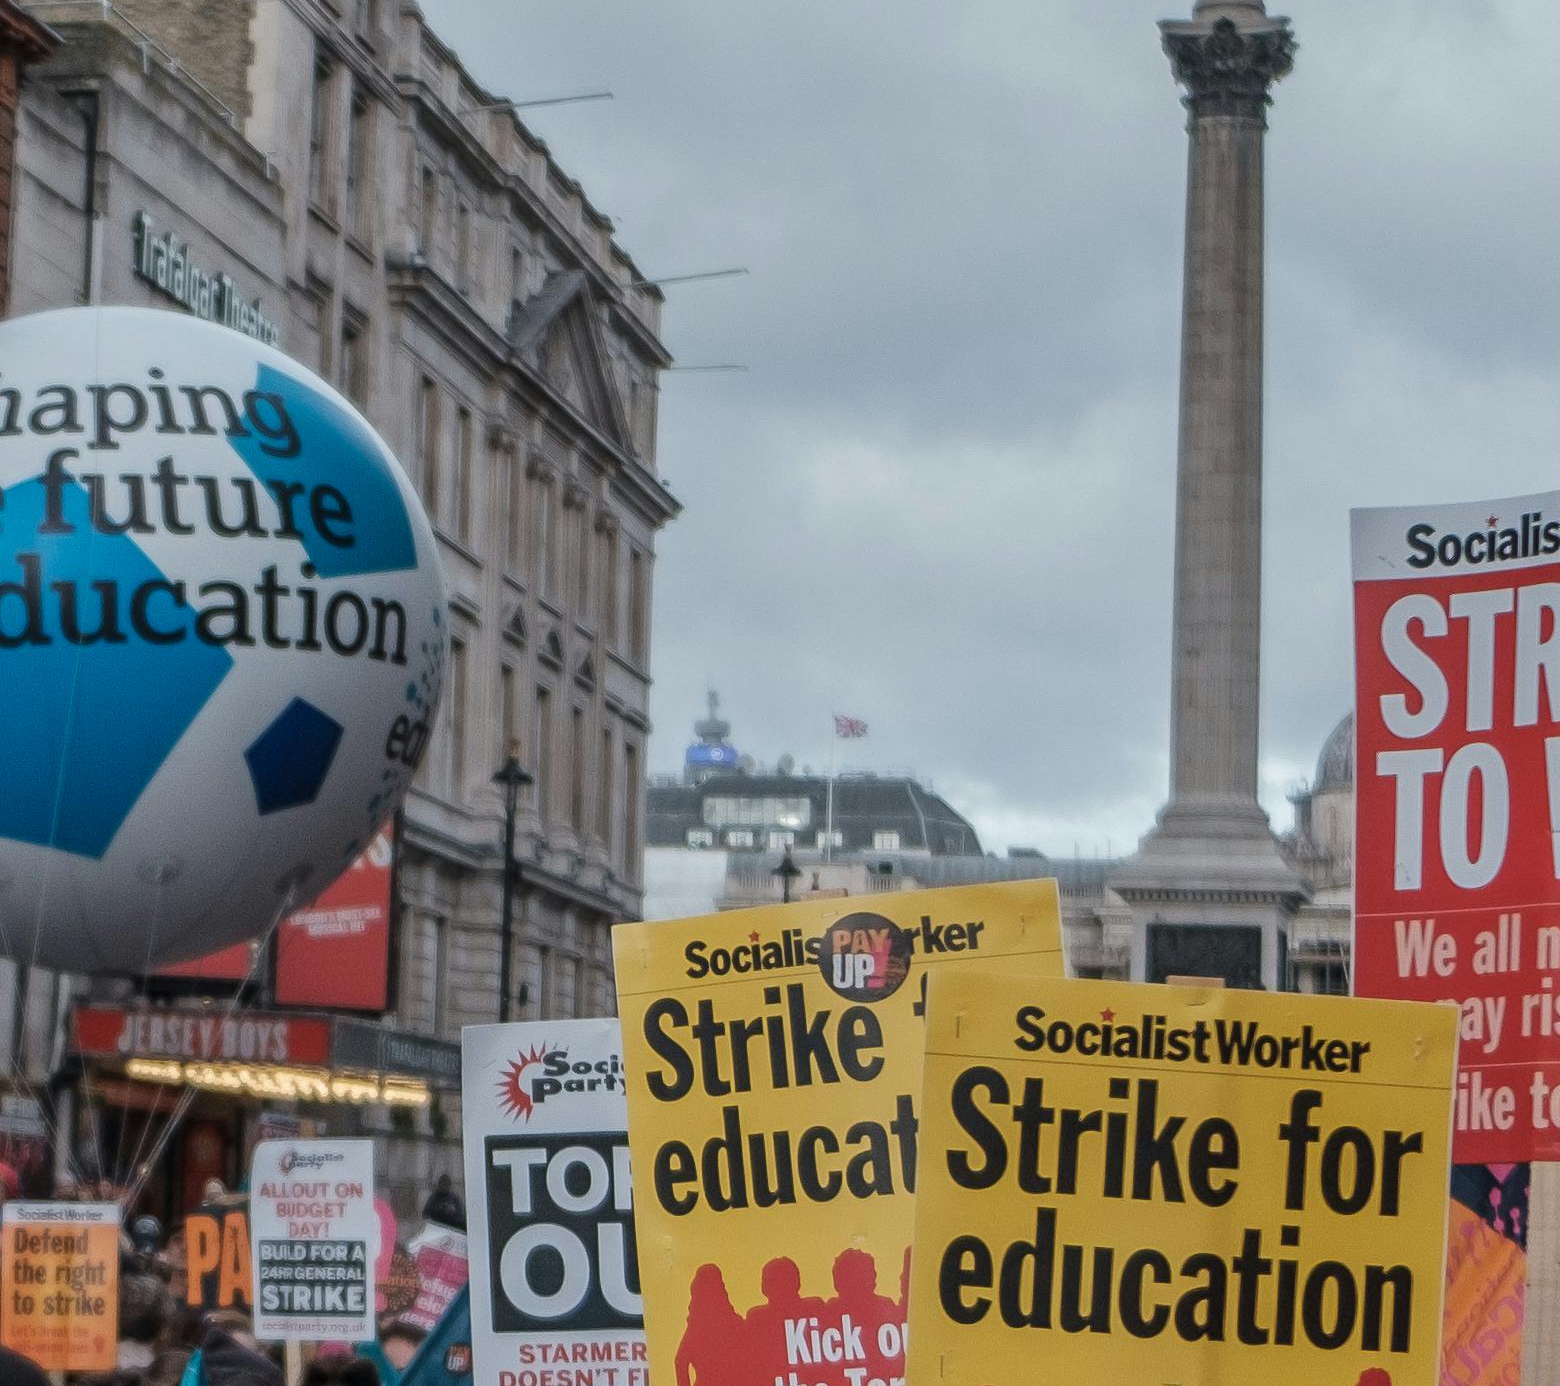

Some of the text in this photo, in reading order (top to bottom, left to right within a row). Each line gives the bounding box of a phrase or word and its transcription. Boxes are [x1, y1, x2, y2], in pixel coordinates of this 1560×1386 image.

[34, 448, 355, 548] future
[1376, 742, 1510, 892] TO
[832, 928, 892, 954] PAY
[1393, 918, 1457, 979] We
[1473, 913, 1521, 976] all
[643, 983, 885, 1103] Strike
[946, 1066, 1425, 1217] Strike for
[335, 1182, 363, 1198] ON
[276, 1202, 347, 1218] BUDGET
[15, 1228, 89, 1254] Defend
[289, 1222, 330, 1238] DAY!
[261, 1244, 364, 1261] BUILD FOR A
[14, 1259, 106, 1291] the right
[294, 1266, 365, 1280] GENERAL
[937, 1207, 1416, 1355] education
[13, 1289, 105, 1315] to strike
[262, 1285, 365, 1311] STRIKE
[784, 1314, 866, 1365] Kick
